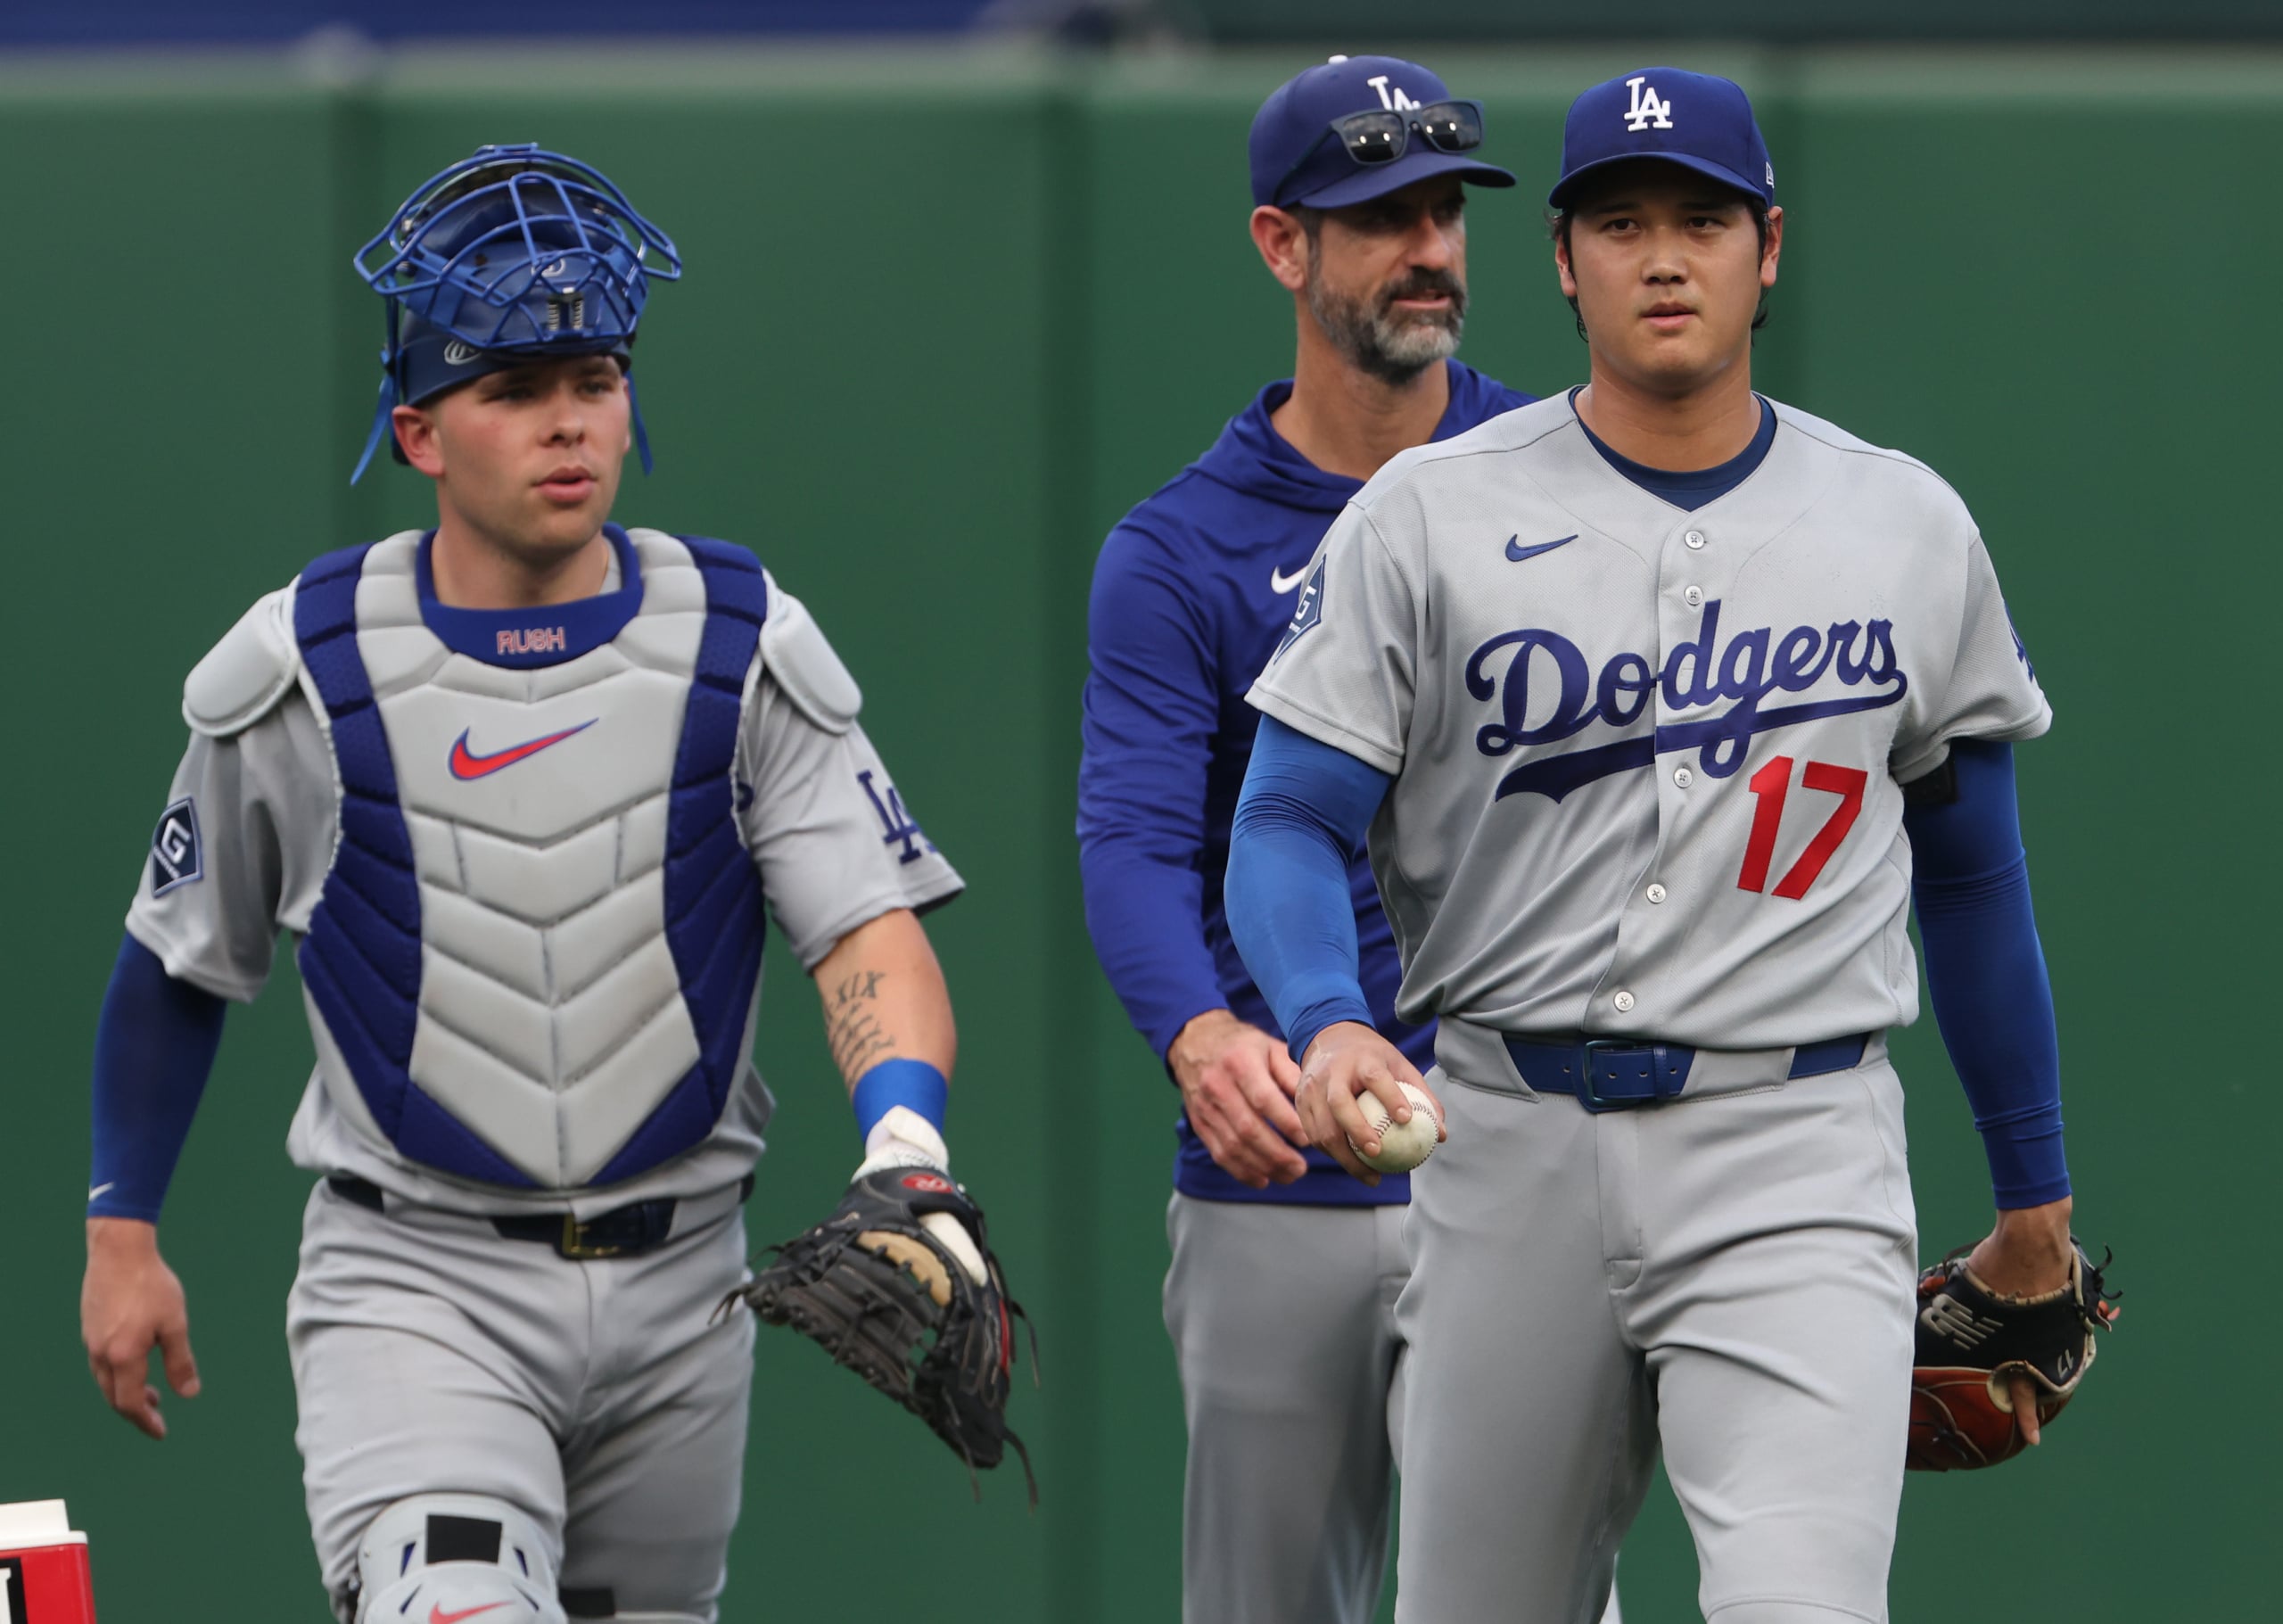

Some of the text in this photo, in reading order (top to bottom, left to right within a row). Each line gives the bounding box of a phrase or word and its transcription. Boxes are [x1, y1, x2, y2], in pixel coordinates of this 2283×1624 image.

[1624, 77, 1674, 131] LA
[496, 626, 566, 655] RUSH
[1465, 598, 1908, 779] Dodgers
[1737, 755, 1867, 901] 17
